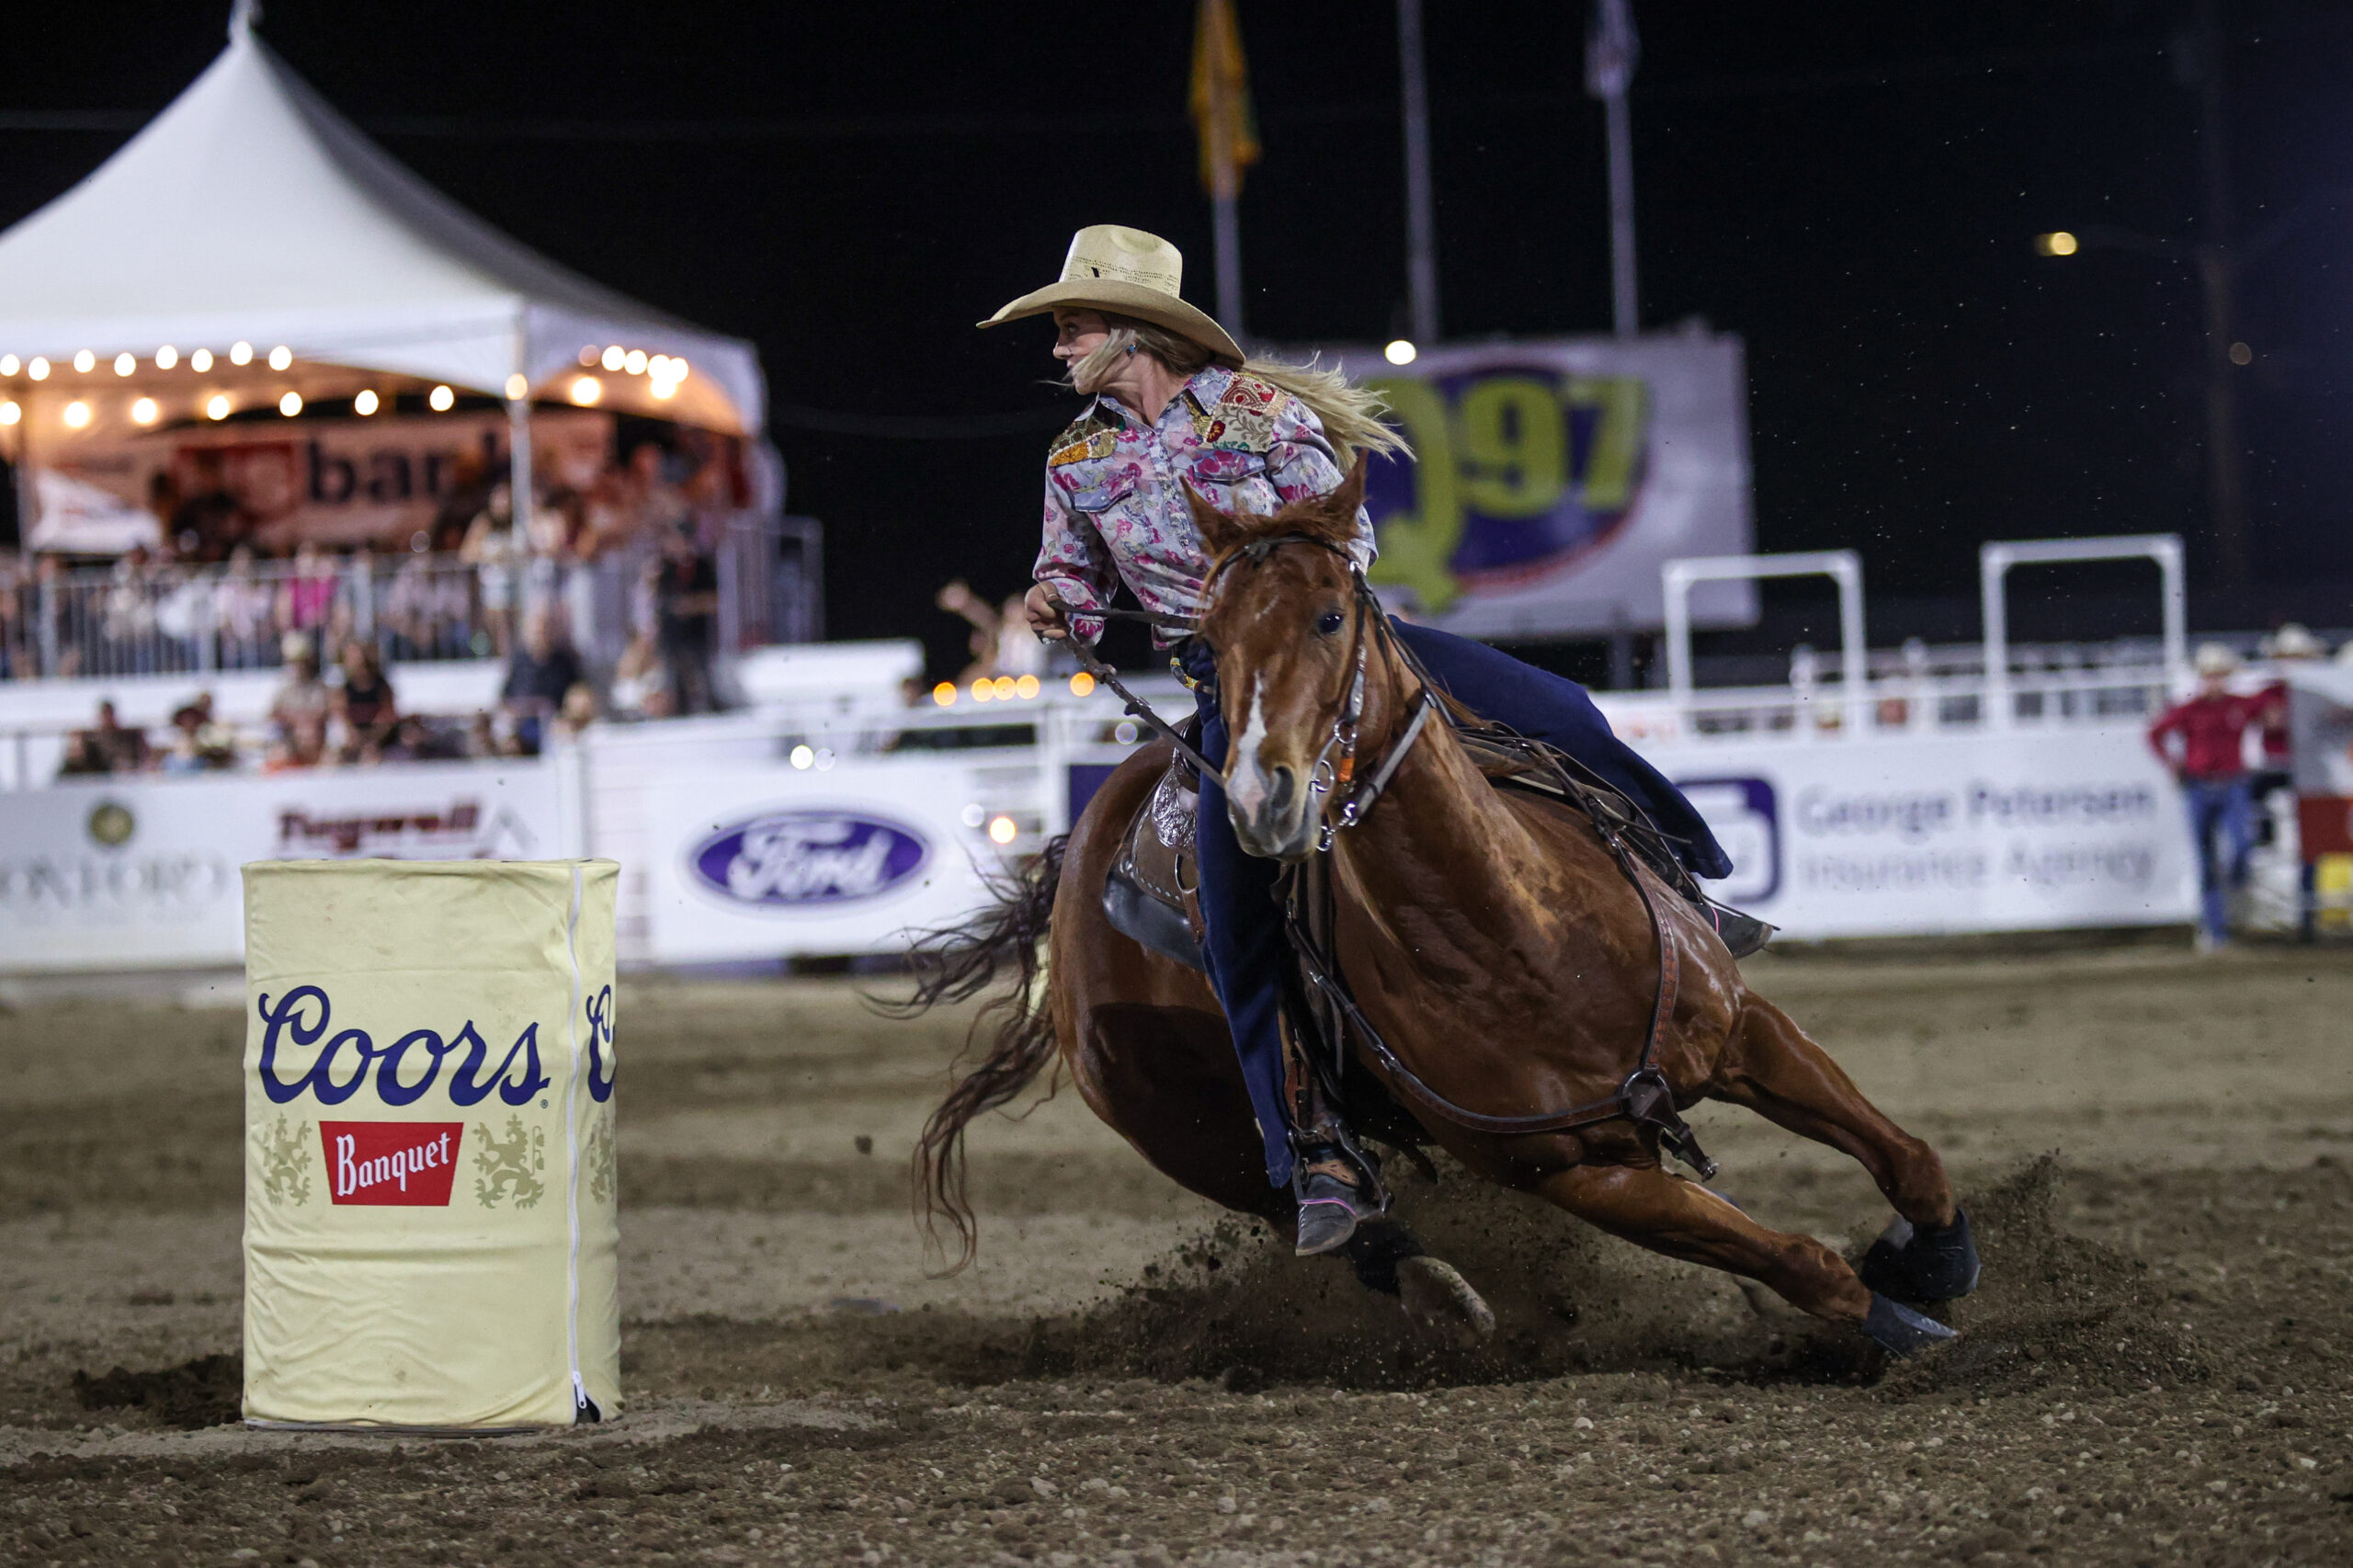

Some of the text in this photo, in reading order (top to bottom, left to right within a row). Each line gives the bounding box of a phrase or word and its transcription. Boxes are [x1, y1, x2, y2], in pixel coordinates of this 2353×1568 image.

[1797, 786, 1955, 843] George
[723, 818, 895, 901] Ford
[258, 984, 551, 1107] Coors
[335, 1131, 451, 1197] Banquet
